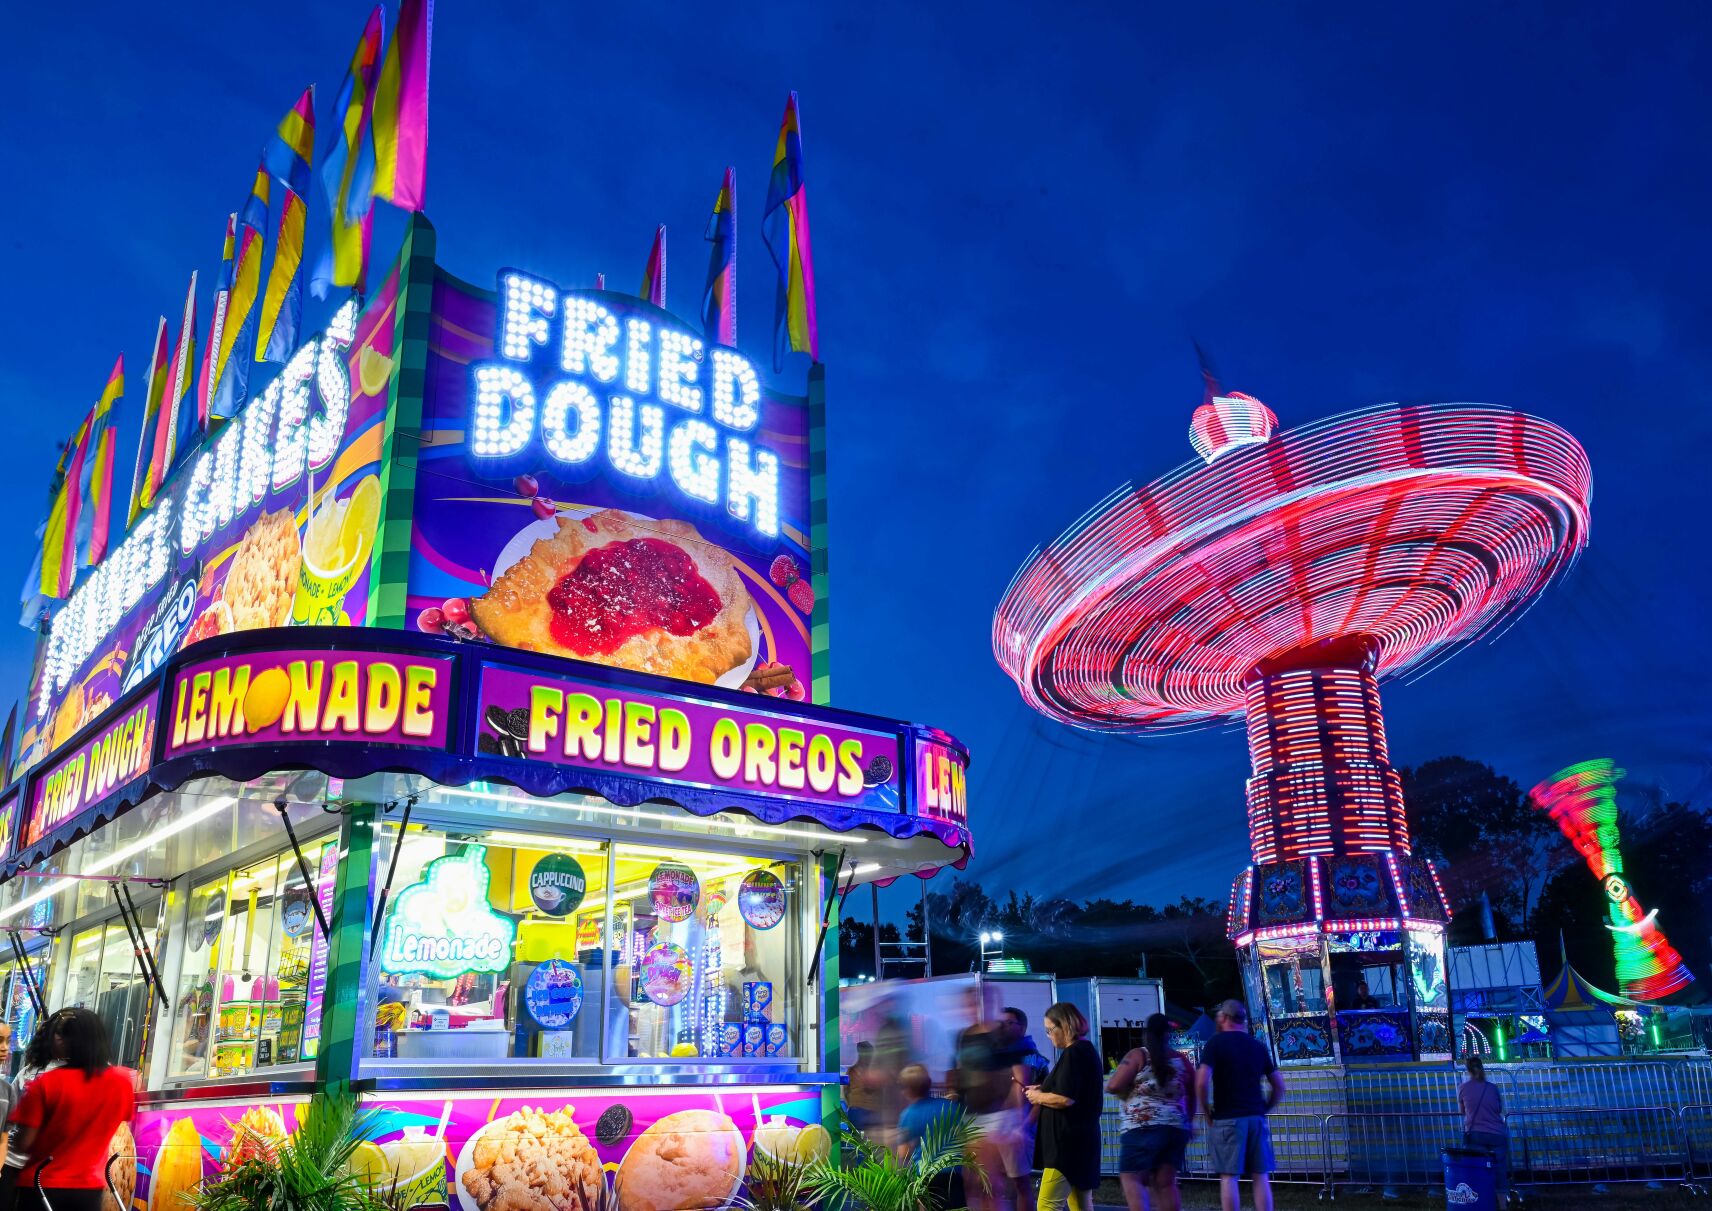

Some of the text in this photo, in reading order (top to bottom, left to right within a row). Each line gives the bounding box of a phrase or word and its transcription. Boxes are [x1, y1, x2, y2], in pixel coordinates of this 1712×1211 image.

[502, 275, 760, 431] FRIED
[180, 298, 358, 556] CAKES
[473, 366, 778, 537] DOUGH
[154, 580, 179, 623] FRIED
[172, 660, 437, 749] LEMONADE
[528, 685, 865, 797] FRIED OREOS
[40, 703, 149, 832] FRIED DOUGH
[532, 871, 585, 893] CAPPUCCINO
[655, 900, 672, 915] SWEET
[681, 903, 692, 915] TEA
[656, 868, 694, 886] LEMONADE
[391, 924, 503, 962] Lemonade
